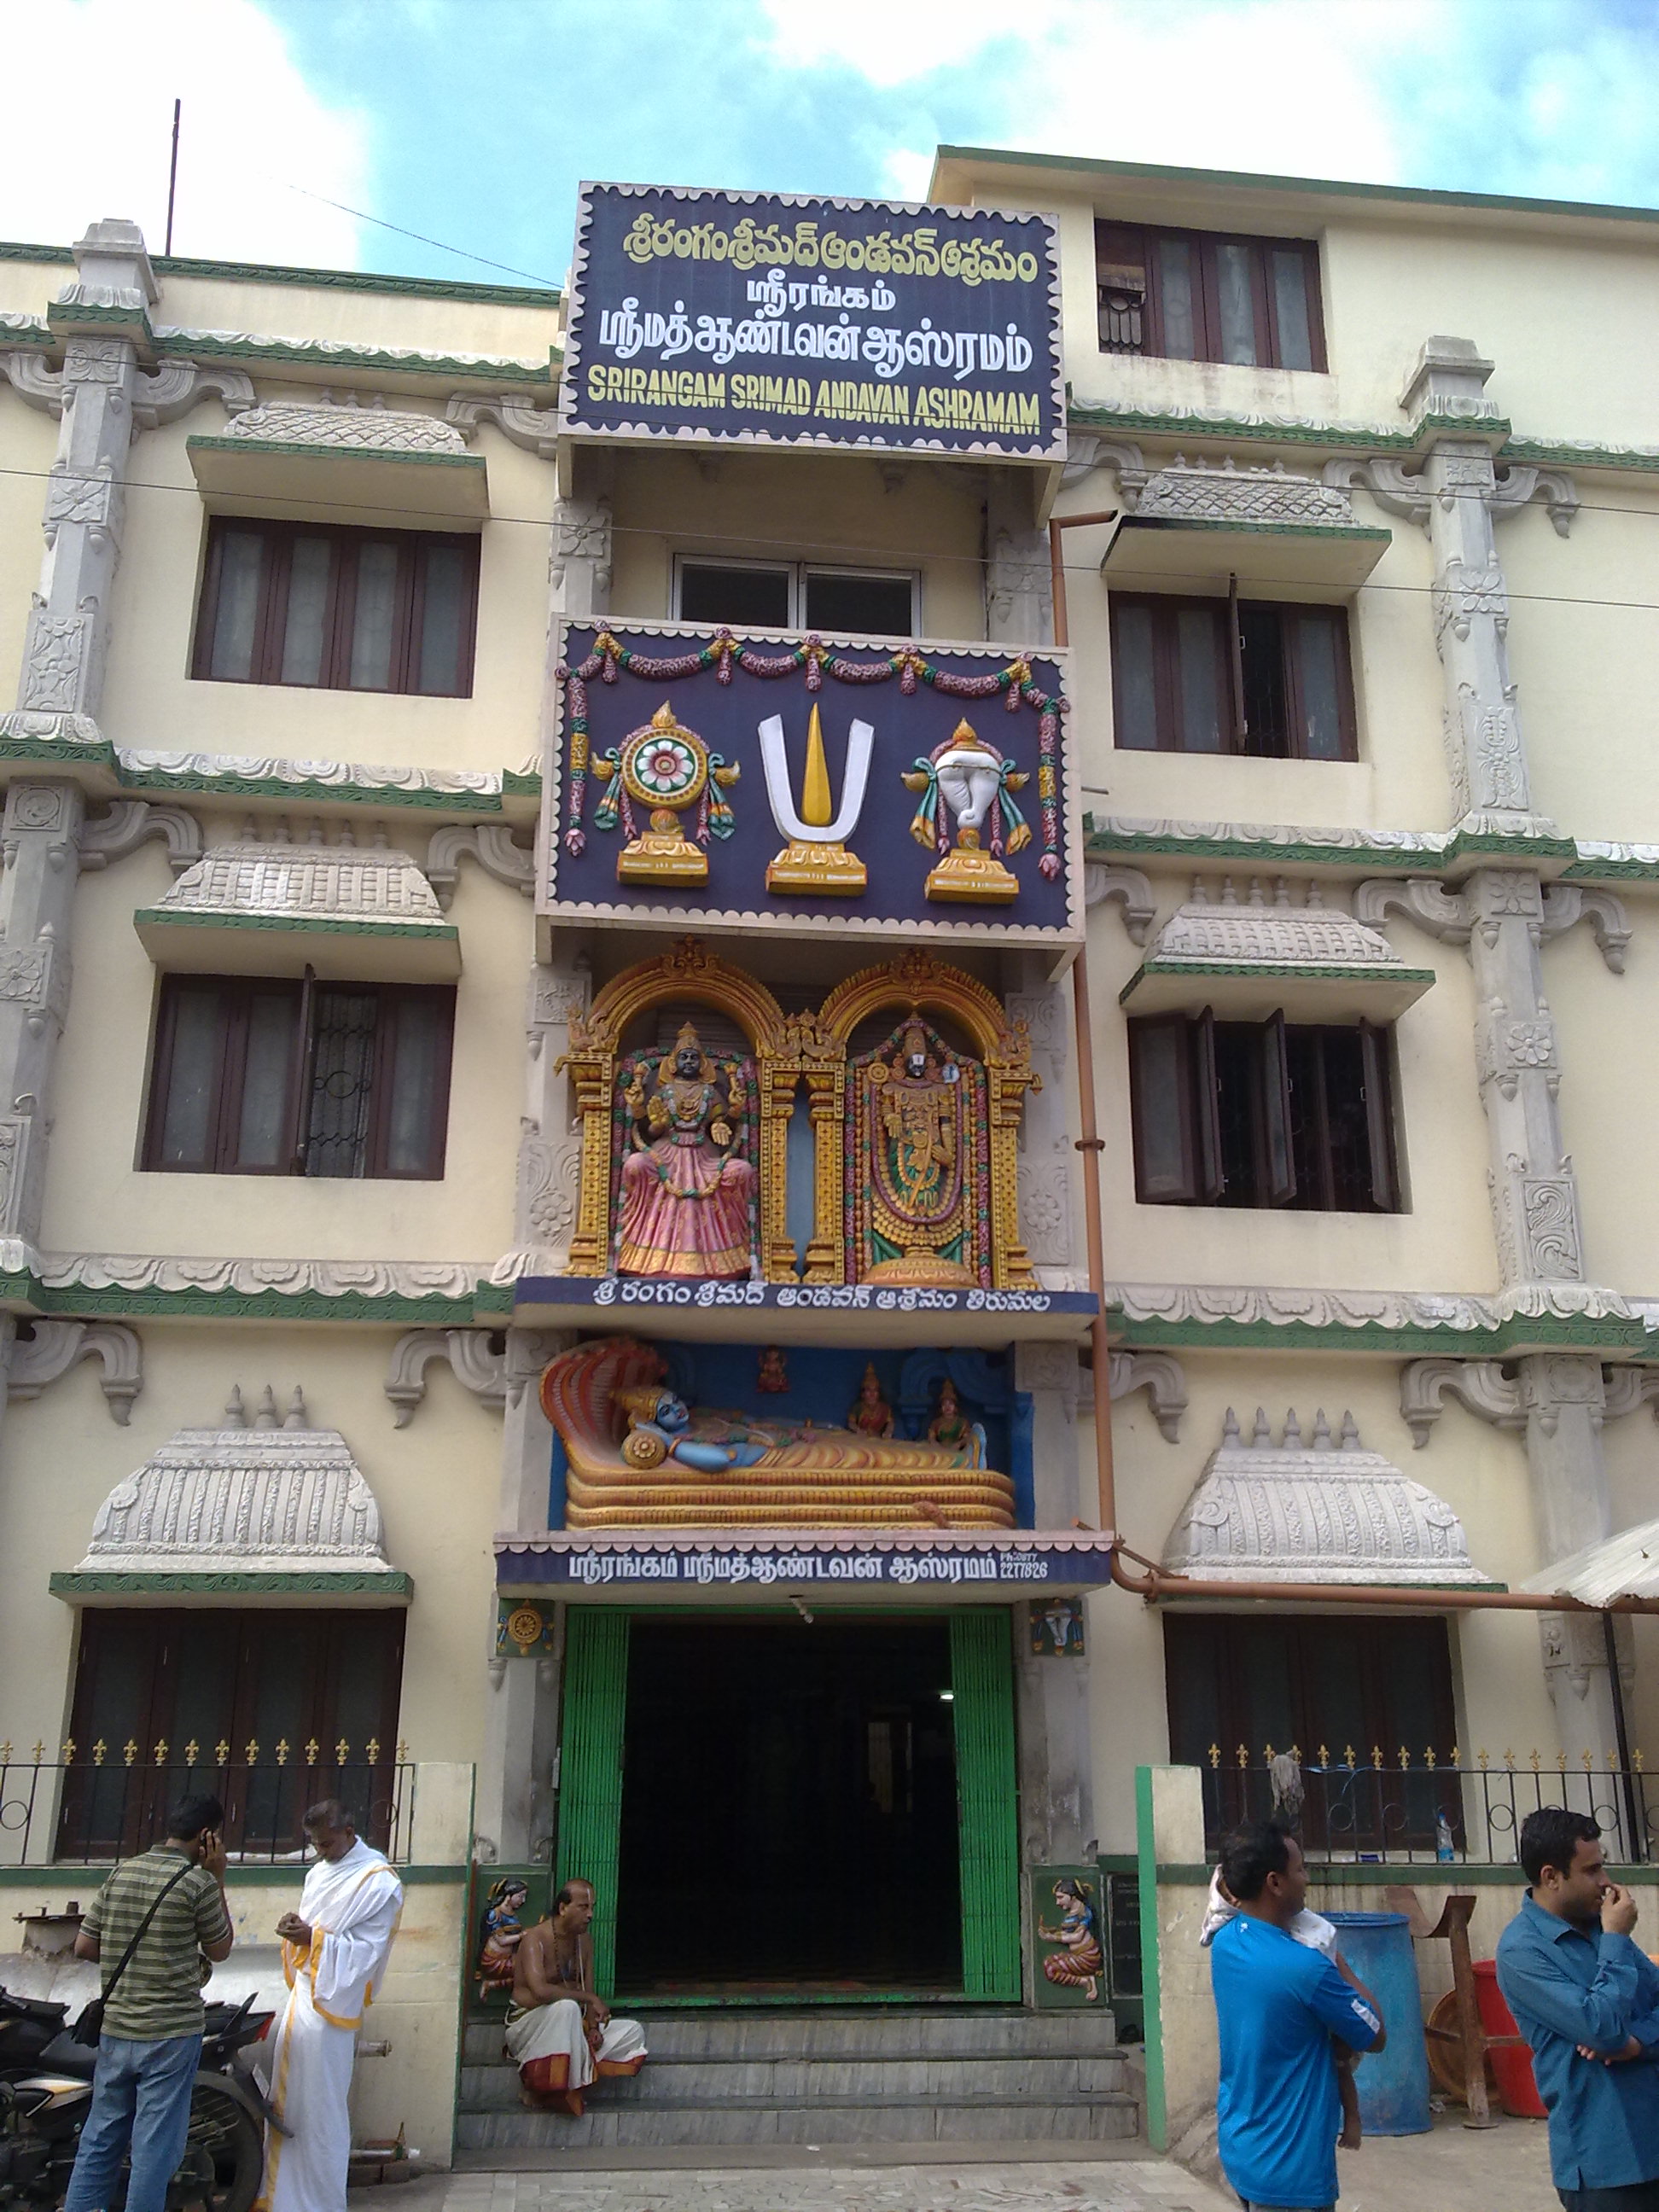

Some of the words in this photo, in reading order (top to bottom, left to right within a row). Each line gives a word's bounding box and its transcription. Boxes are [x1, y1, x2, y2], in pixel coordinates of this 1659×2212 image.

[587, 364, 726, 409] SRIRANGAM
[731, 374, 812, 416] SRIMAD
[813, 380, 910, 426] ANDAVAN
[912, 386, 1041, 436] ASHRAMAM
[1000, 1563, 1048, 1579] 2277826
